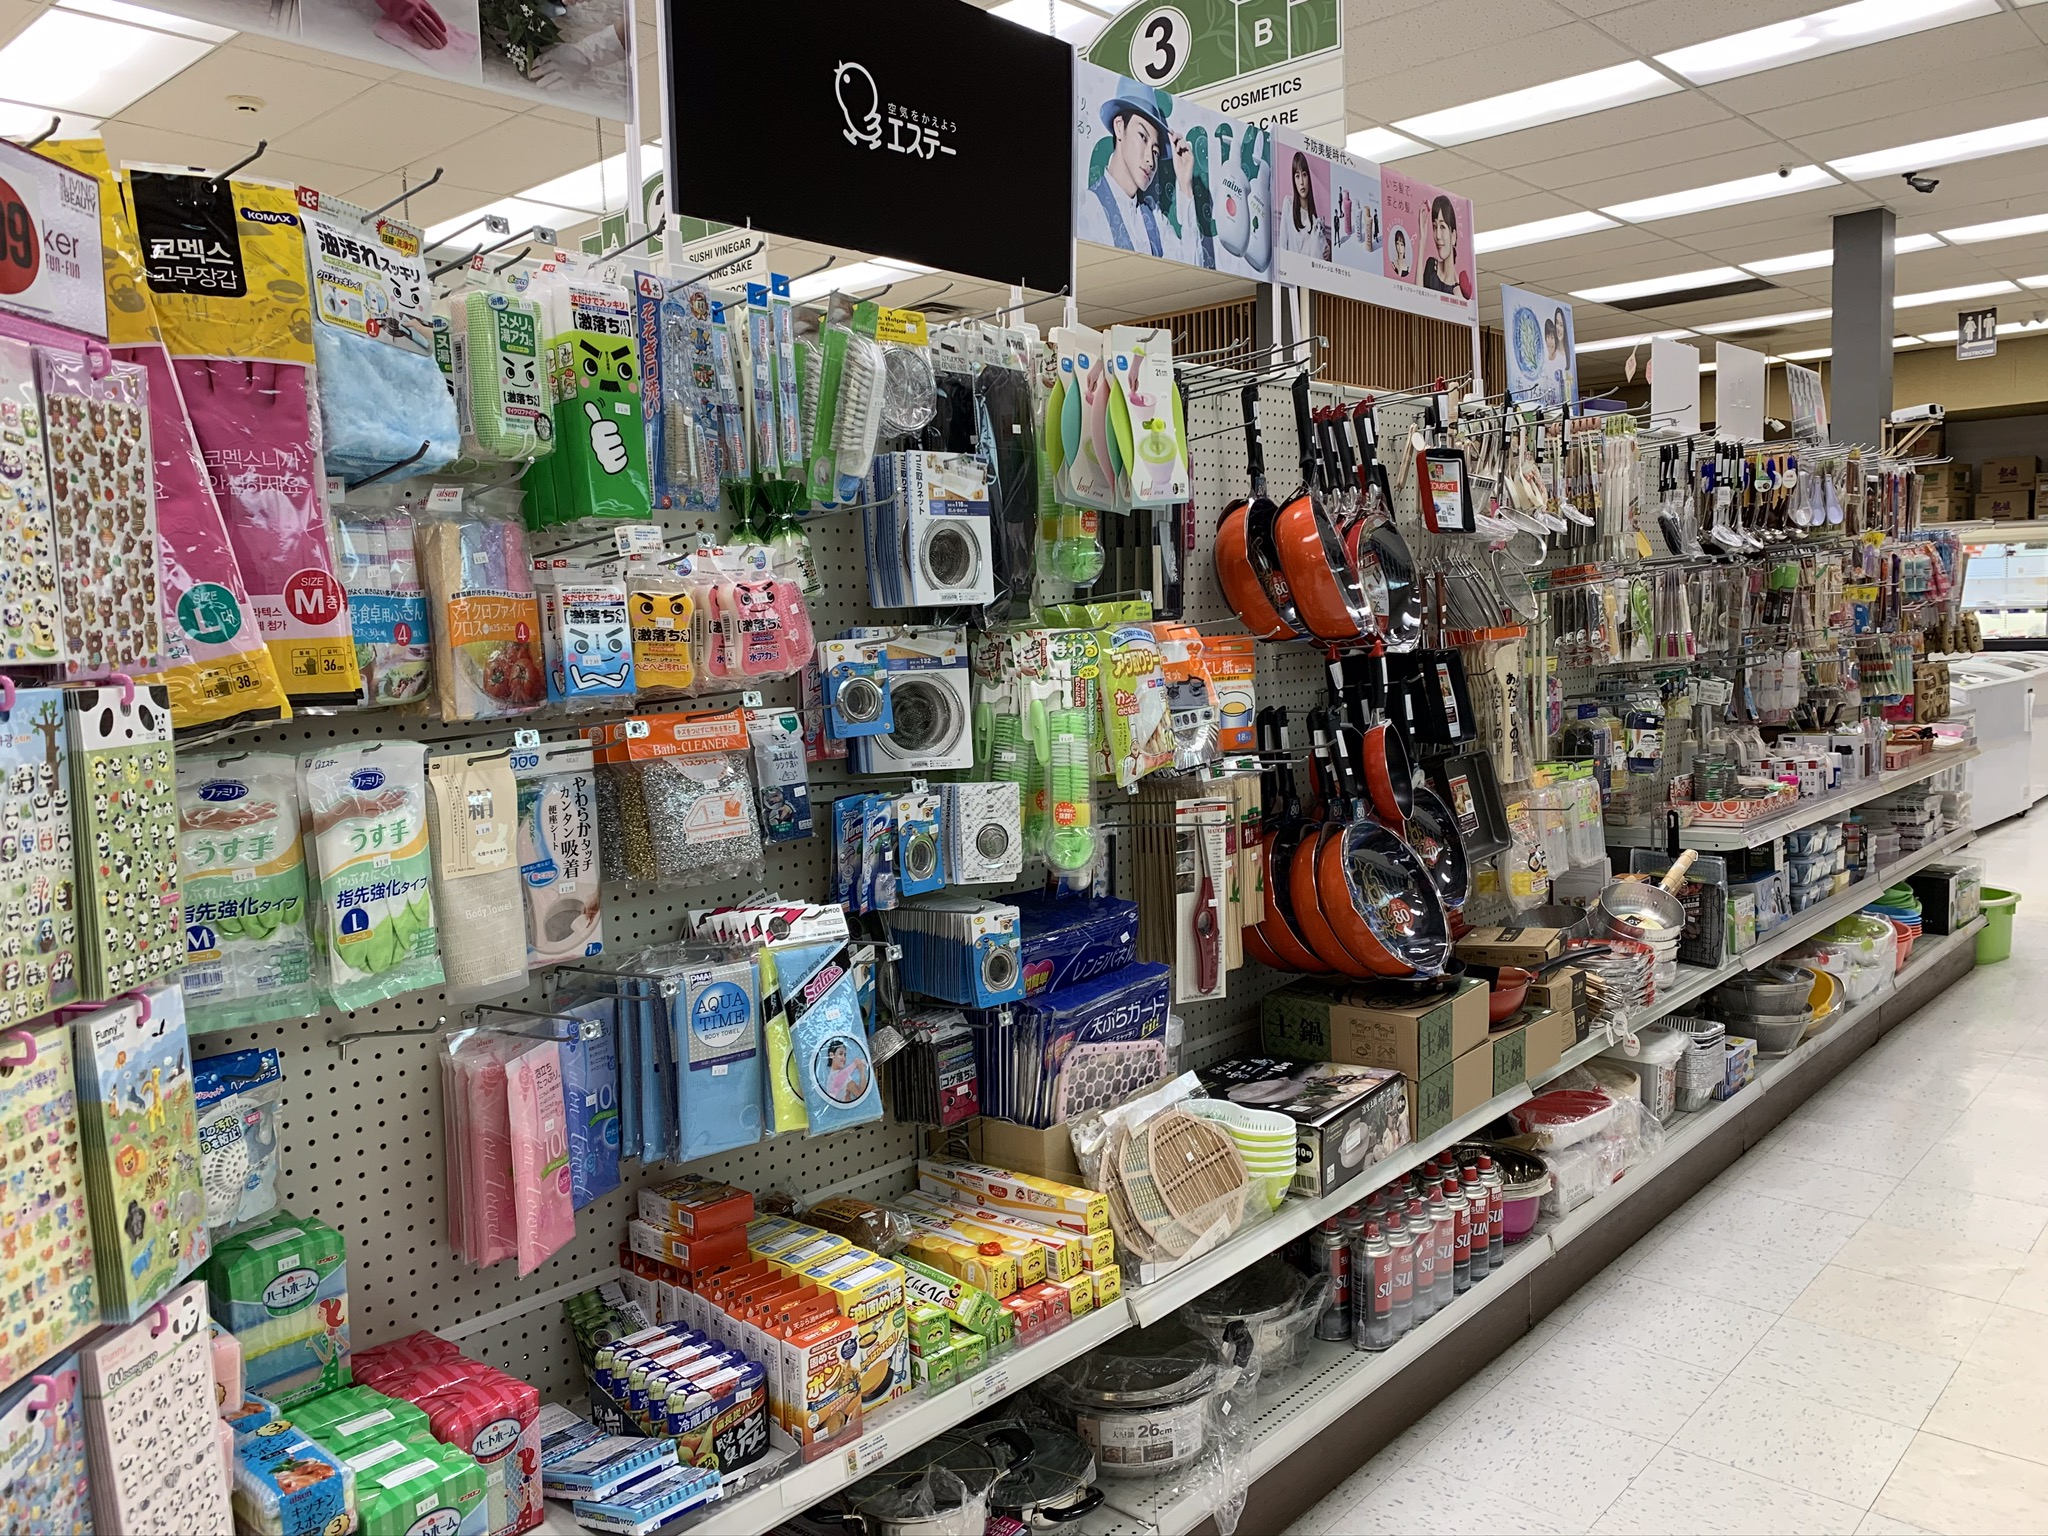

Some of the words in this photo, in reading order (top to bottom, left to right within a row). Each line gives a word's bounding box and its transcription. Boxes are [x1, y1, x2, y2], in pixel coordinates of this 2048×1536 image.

[1254, 17, 1274, 48] B
[1144, 16, 1176, 80] 3
[1220, 76, 1302, 113] COSMETICS
[887, 102, 957, 134] 空気をかえよう
[1259, 108, 1299, 131] CARE
[887, 116, 957, 160] エステー
[1303, 136, 1357, 168] 予防美髪時代へ。
[1222, 177, 1243, 197] naive
[246, 210, 292, 225] KOMAX
[150, 238, 235, 266] 코멕스
[316, 228, 421, 284] 油汚れスッキリ
[689, 248, 713, 264] SUSHI
[714, 237, 752, 258] VINEGAR
[153, 265, 239, 291] 고무장갑
[730, 259, 753, 276] SAKE
[570, 293, 629, 311] 水だけでスッキリ!
[1960, 348, 1994, 357] RESTROOM
[204, 448, 302, 471] 코멕스니까
[915, 453, 926, 516] ゴミ取りネット
[300, 577, 324, 587] SIZE
[192, 591, 218, 602] SIZE
[293, 588, 325, 614] M
[562, 593, 625, 602] 水だけでスッキリ!
[194, 607, 221, 635] L
[451, 602, 535, 620] マイクロファイバー
[453, 620, 483, 638] クロス
[323, 658, 337, 671] 36
[236, 676, 251, 689] 38
[653, 738, 730, 756] Bath-CLEANER
[350, 819, 409, 852] うす手
[548, 804, 559, 851] 便座シート
[559, 785, 580, 880] カンタン吸着
[572, 775, 594, 873] やわらかタッチ
[198, 834, 275, 867] うす手
[336, 876, 428, 909] 指先強化タイプ
[352, 913, 361, 931] L
[465, 906, 488, 920] Body
[1393, 909, 1410, 924] 80
[186, 931, 212, 951] M
[1071, 943, 1136, 982] レンジパネル
[695, 992, 745, 1015] AQUA
[699, 1009, 745, 1032] TIME
[1090, 995, 1165, 1039] 天ぷらガード
[95, 1025, 118, 1042] Funny
[704, 1032, 720, 1041] BODY
[721, 1028, 741, 1037] TOWEL
[1268, 1013, 1325, 1047] 土鍋
[534, 1062, 553, 1079] 泡立ち
[1471, 1205, 1485, 1214] SUN
[1470, 1220, 1489, 1237] SUN
[265, 1276, 317, 1305] ハートホーム
[1377, 1281, 1393, 1299] SU
[809, 1350, 838, 1370] 固めて
[807, 1366, 843, 1400] ポン
[889, 1385, 903, 1400] 10
[475, 1425, 519, 1455] ハートホーム
[1138, 1423, 1160, 1439] 26
[292, 1494, 336, 1519] キッチン
[292, 1505, 338, 1535] スポンジ
